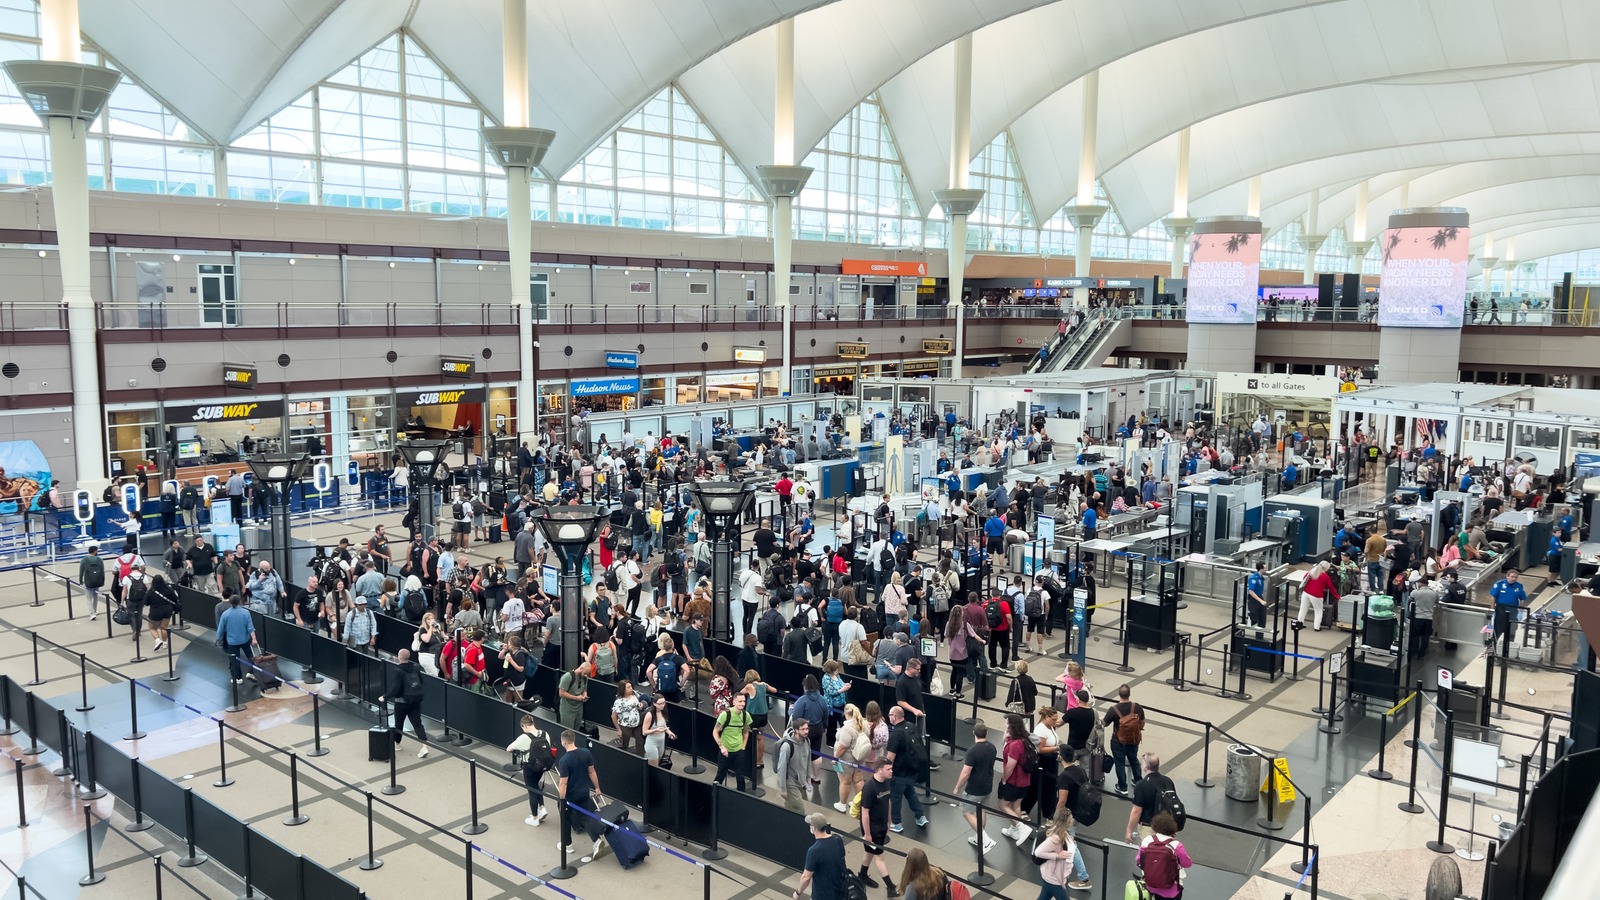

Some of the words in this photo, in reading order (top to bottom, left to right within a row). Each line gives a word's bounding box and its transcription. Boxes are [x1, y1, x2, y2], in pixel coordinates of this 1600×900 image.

[1388, 259, 1416, 268] WHEN
[1418, 259, 1450, 268] YOUR
[1190, 270, 1213, 278] VACAY
[1214, 270, 1246, 278] NEEDS
[1385, 268, 1413, 276] VACAY
[1416, 268, 1453, 277] NEEDS
[1189, 278, 1225, 286] ANOTHER
[1226, 278, 1246, 286] DAY
[1384, 278, 1428, 286] ANOTHER
[1432, 278, 1453, 286] DAY
[442, 362, 470, 372] SUBWAY
[225, 371, 252, 382] SUBWAY
[575, 384, 608, 394] Hudson
[610, 382, 634, 392] News
[416, 390, 466, 405] SUBWAY
[192, 403, 258, 420] SUBWAY
